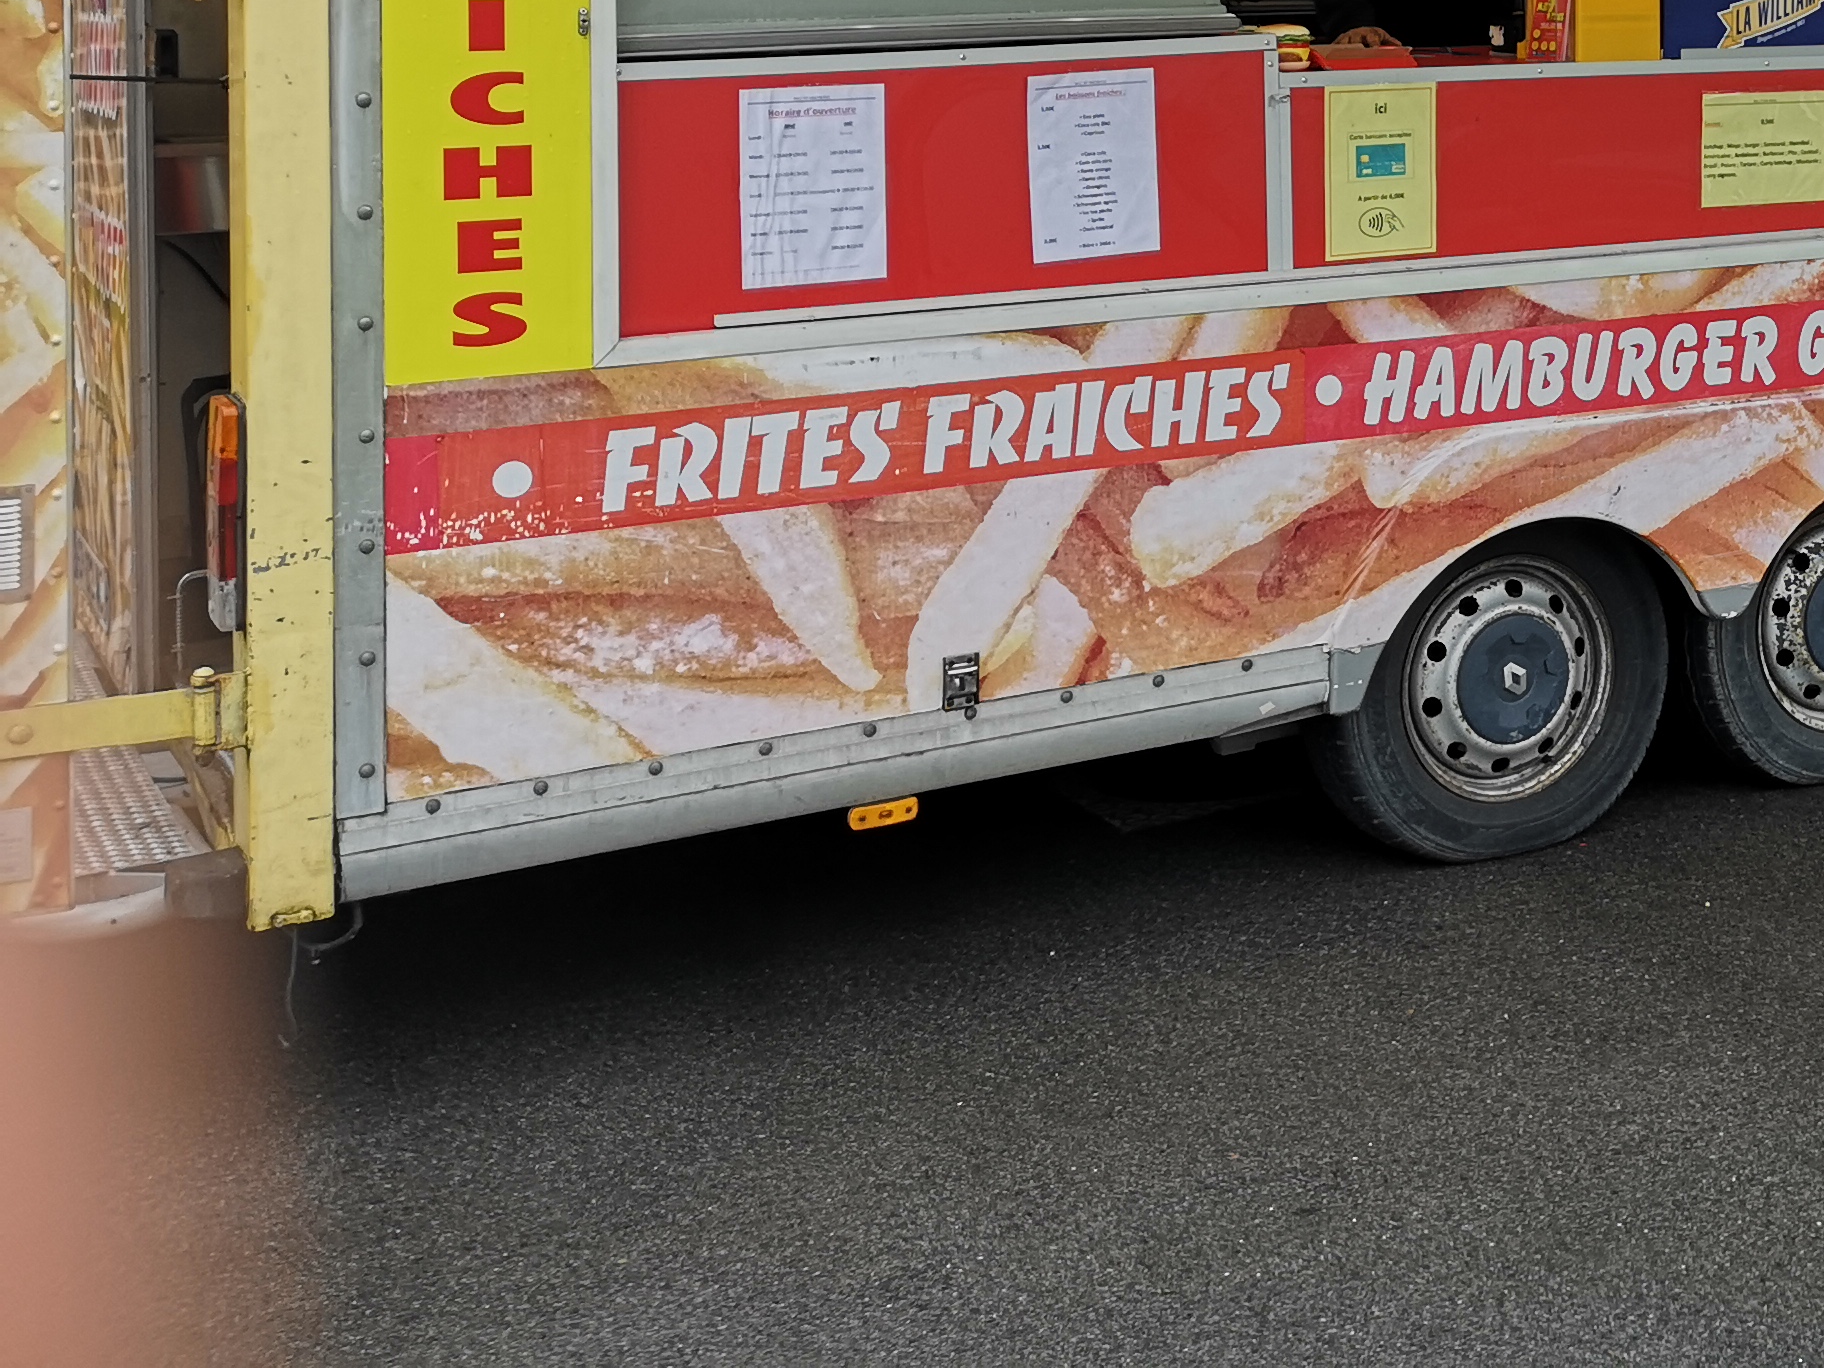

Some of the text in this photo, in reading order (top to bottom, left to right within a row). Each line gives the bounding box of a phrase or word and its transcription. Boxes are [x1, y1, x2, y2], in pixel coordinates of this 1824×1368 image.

[1736, 5, 1751, 35] LA
[1374, 102, 1387, 114] ici
[1362, 313, 1779, 427] HAMBURGER
[599, 362, 1291, 513] FRITES FRAICHES
